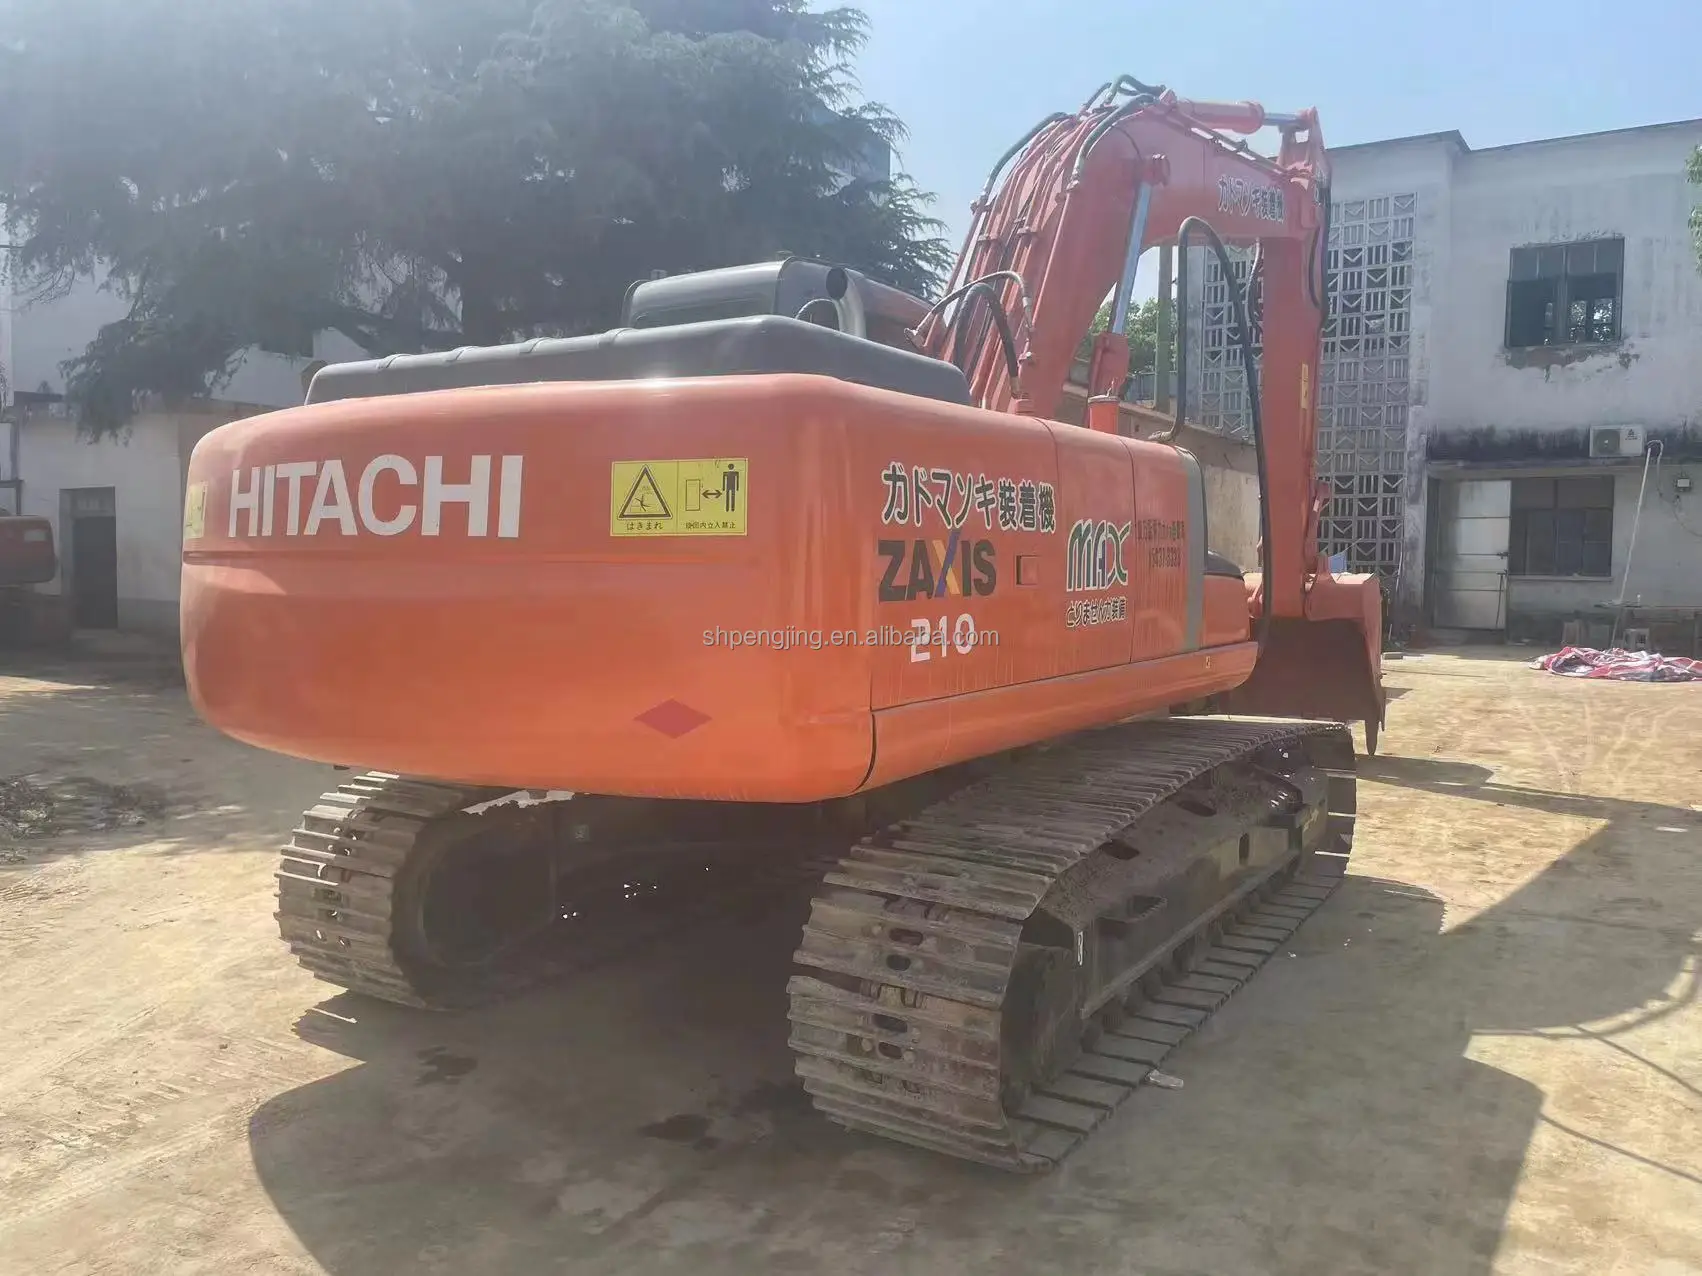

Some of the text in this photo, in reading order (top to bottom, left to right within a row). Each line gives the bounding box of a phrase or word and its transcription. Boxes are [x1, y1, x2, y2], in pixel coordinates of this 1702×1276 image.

[228, 454, 524, 538] HITACHI
[878, 529, 996, 603] ZAXIS
[1066, 519, 1131, 592] MAX
[910, 613, 975, 663] 210
